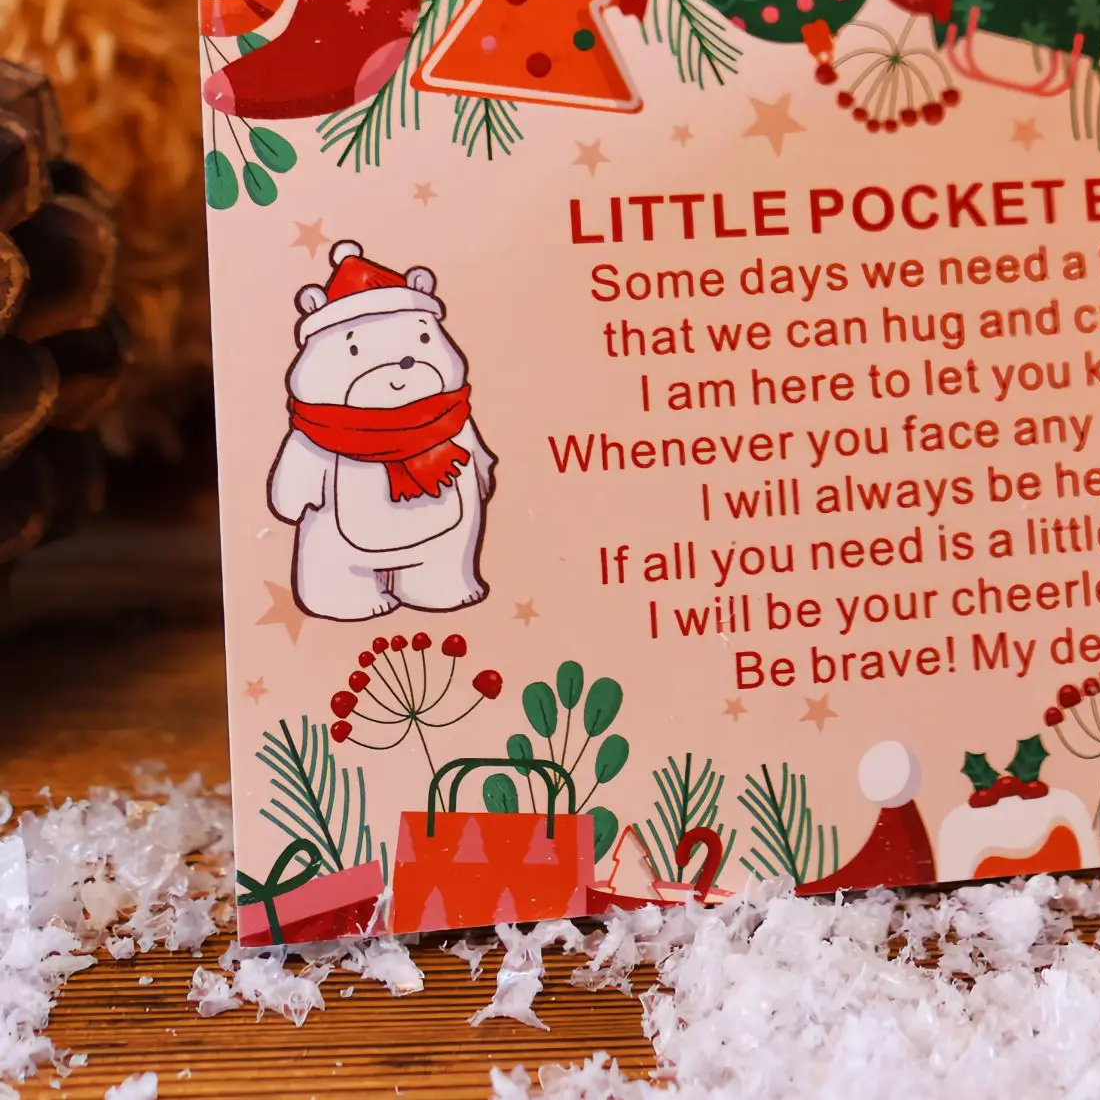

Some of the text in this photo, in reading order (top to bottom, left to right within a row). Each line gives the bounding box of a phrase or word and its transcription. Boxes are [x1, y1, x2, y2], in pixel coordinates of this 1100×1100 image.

[570, 190, 789, 244] LITTLE
[810, 179, 1065, 234] POCKET
[591, 264, 724, 302] Some
[740, 258, 848, 302] days
[861, 260, 924, 289] we
[939, 245, 1049, 285] need
[1063, 252, 1086, 281] a
[603, 318, 695, 357] that
[706, 322, 772, 352] we
[787, 317, 867, 348] can
[883, 307, 965, 350] hug
[980, 299, 1060, 338] and
[641, 375, 650, 412] I
[668, 379, 735, 410] am
[751, 369, 854, 405] here
[868, 364, 910, 399] to
[924, 359, 980, 395] let
[991, 362, 1071, 402] you
[548, 432, 794, 473] Whenever
[806, 427, 888, 468] you
[902, 414, 999, 452] face
[1014, 415, 1093, 452] any
[702, 484, 709, 521] I
[724, 478, 800, 519] will
[816, 475, 974, 517] always
[988, 466, 1041, 502] be
[600, 545, 629, 585] If
[644, 541, 696, 582] all
[711, 544, 794, 587] you
[811, 526, 923, 570] need
[938, 525, 974, 561] is
[989, 529, 1013, 558] a
[650, 601, 658, 639] I
[674, 594, 750, 636] will
[766, 593, 822, 630] be
[836, 590, 938, 635] your
[735, 651, 795, 689] Be
[811, 636, 954, 684] brave!
[972, 632, 1036, 678] My
